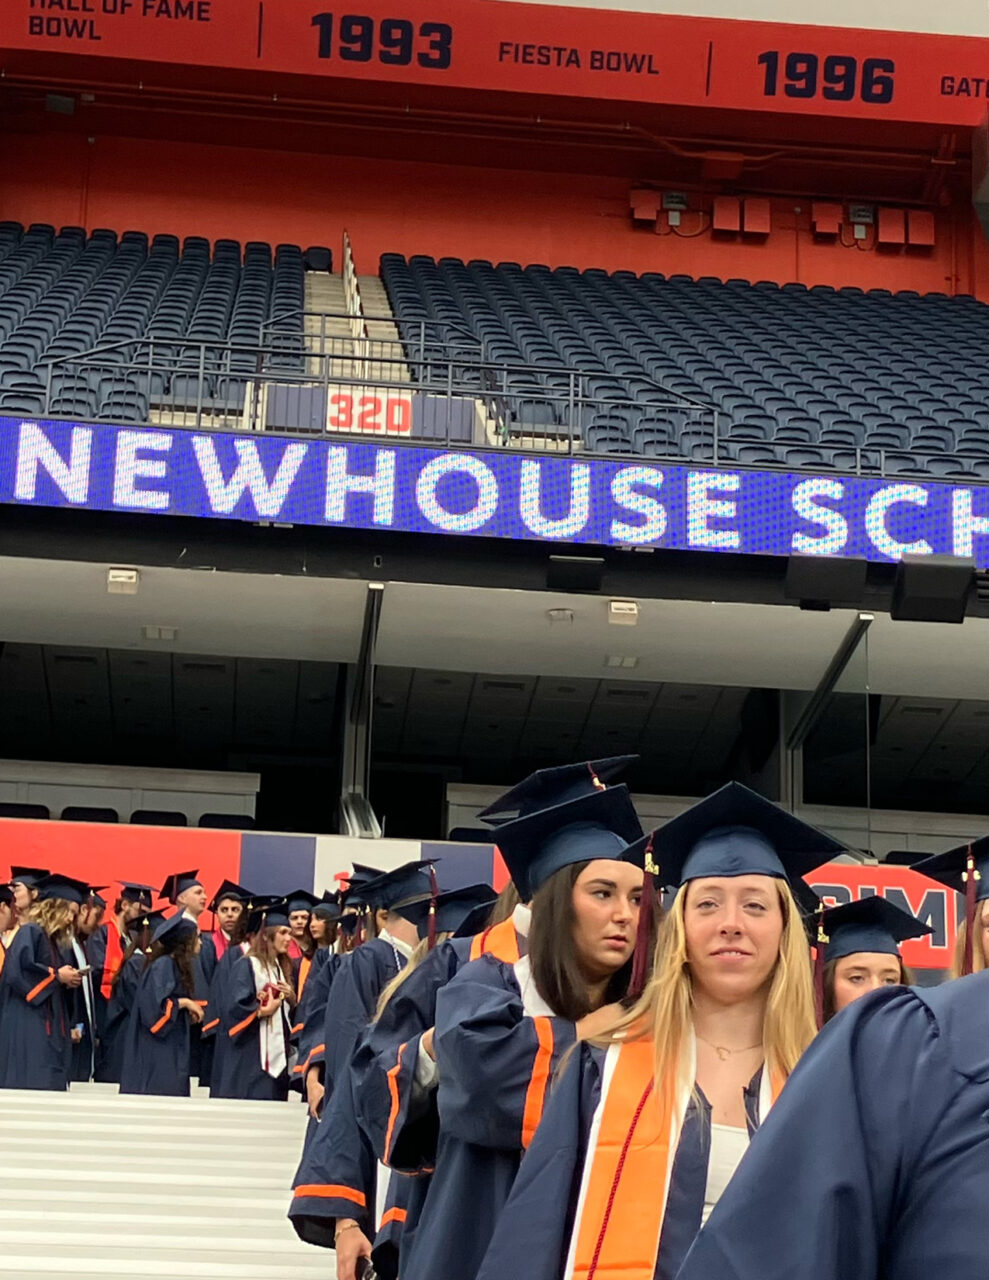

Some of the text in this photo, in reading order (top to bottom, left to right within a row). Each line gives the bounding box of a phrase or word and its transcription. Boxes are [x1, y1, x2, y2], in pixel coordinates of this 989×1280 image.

[28, 15, 102, 41] BOWL
[102, 0, 133, 15] OF
[142, 0, 211, 22] FAME
[311, 12, 453, 70] 1993
[498, 41, 660, 76] FIESTA BOWL
[757, 50, 896, 105] 1996
[329, 393, 412, 432] 320
[13, 421, 741, 548] NEWHOUSE
